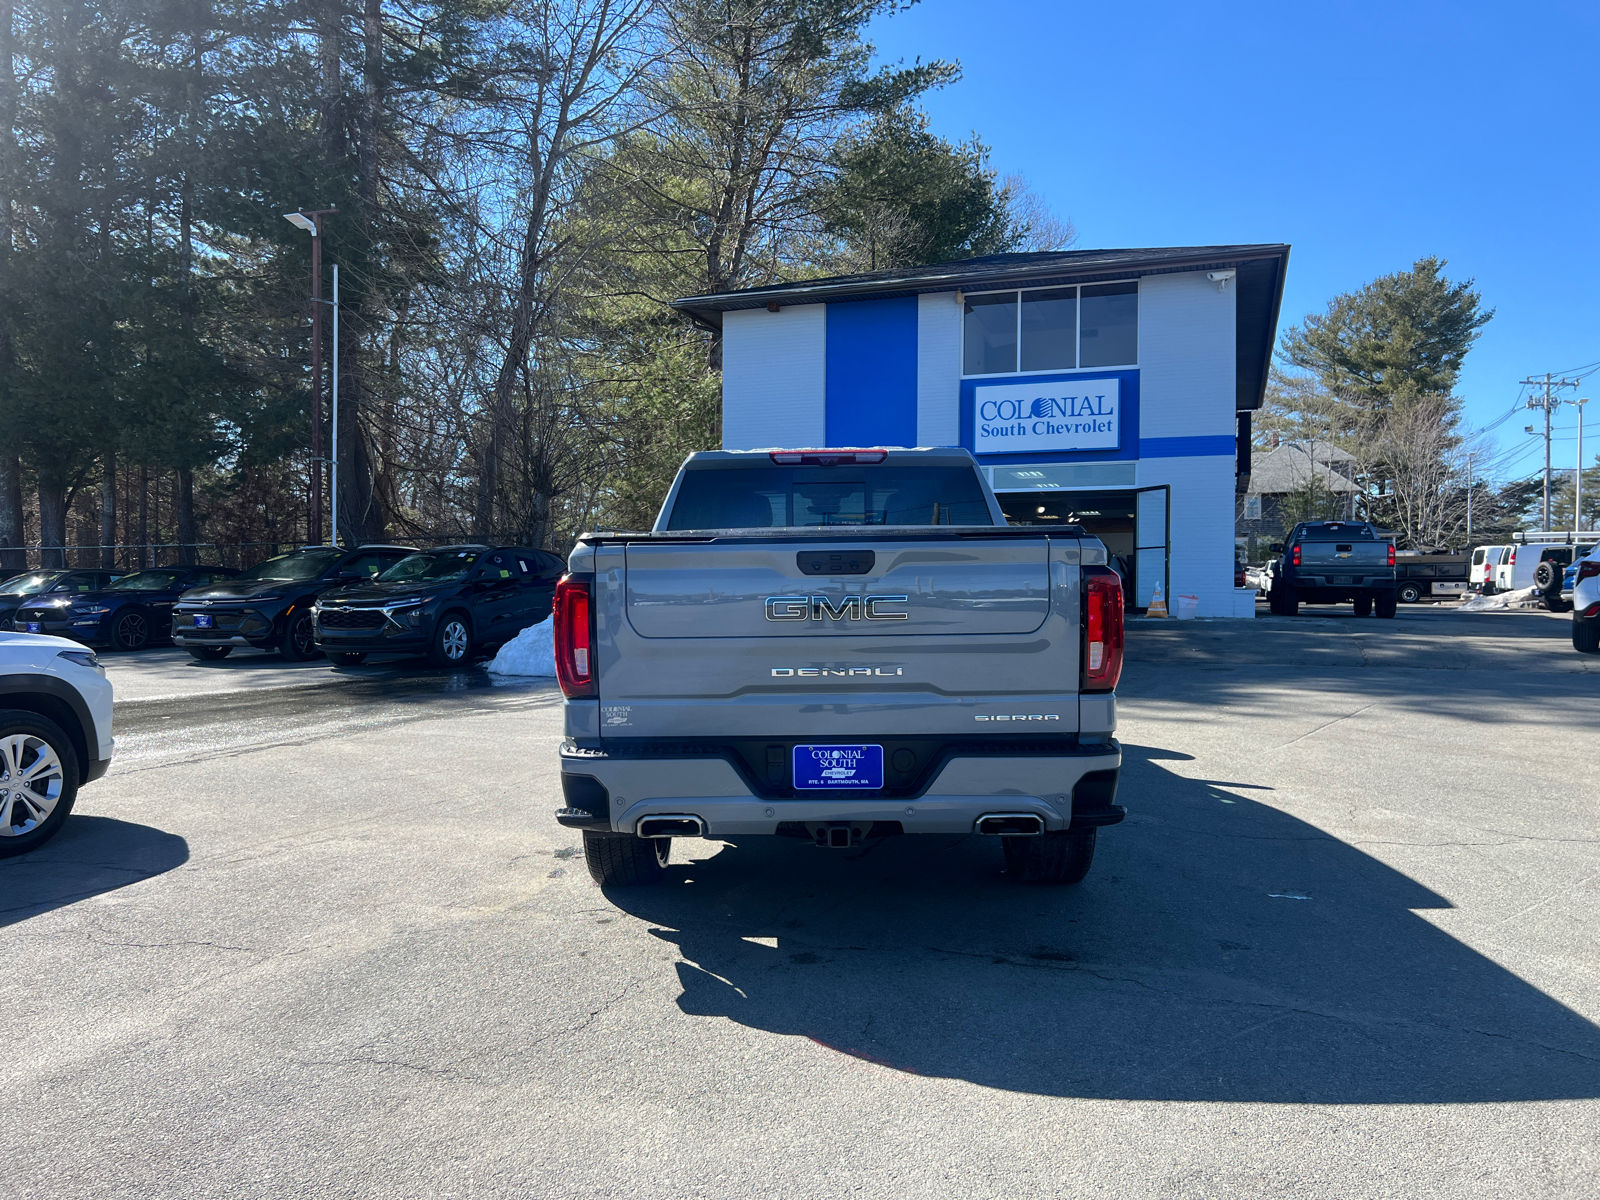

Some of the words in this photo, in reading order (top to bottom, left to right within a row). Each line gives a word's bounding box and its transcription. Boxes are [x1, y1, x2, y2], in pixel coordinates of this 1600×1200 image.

[981, 396, 1113, 421] COLONIAL
[981, 422, 1026, 437] South
[1032, 419, 1113, 435] Chevrolet
[765, 595, 908, 621] GMC
[771, 667, 903, 677] DENALI
[974, 714, 1059, 722] SIERRA
[812, 750, 865, 759] COLONIAL
[820, 759, 856, 767] SOUTH
